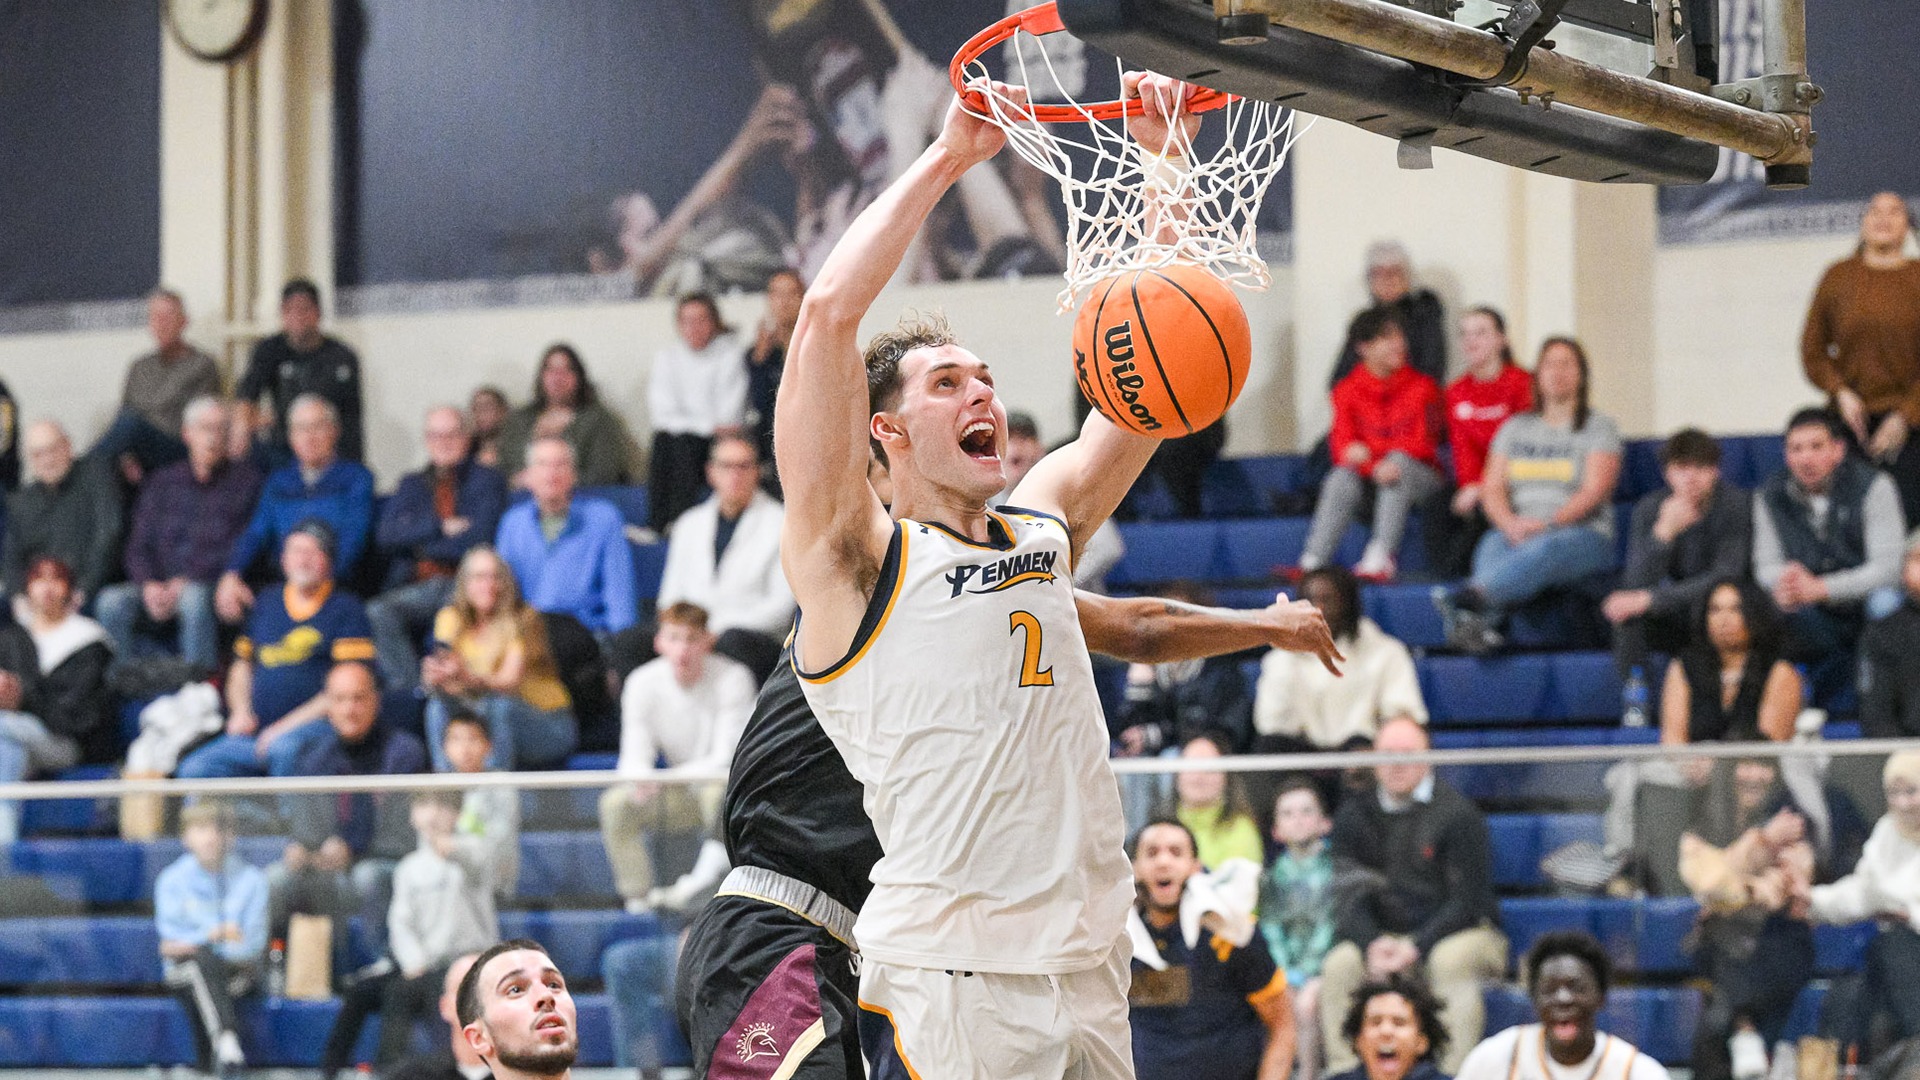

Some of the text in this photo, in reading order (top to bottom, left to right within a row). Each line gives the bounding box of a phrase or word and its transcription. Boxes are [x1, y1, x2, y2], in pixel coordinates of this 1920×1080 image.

[1104, 320, 1163, 431] Wilson
[945, 551, 1057, 599] PENMEN
[1009, 610, 1054, 688] 2
